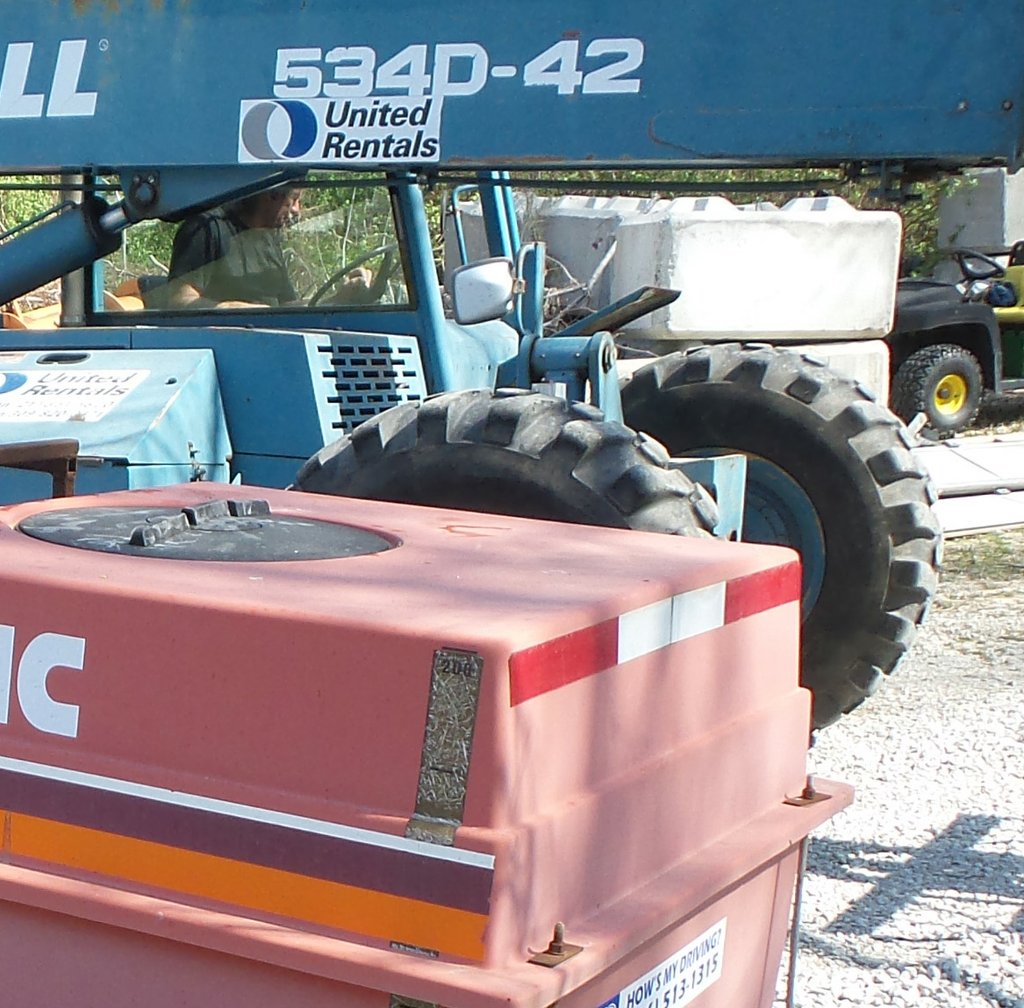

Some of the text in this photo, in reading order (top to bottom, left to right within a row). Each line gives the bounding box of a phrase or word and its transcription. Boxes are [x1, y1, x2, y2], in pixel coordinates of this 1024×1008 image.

[273, 37, 645, 97] 534D-42
[324, 100, 430, 128] United
[321, 131, 439, 160] Rentals
[22, 384, 130, 397] Rentals
[37, 372, 138, 384] United
[662, 960, 679, 987] MY
[679, 927, 722, 975] DRIVING?
